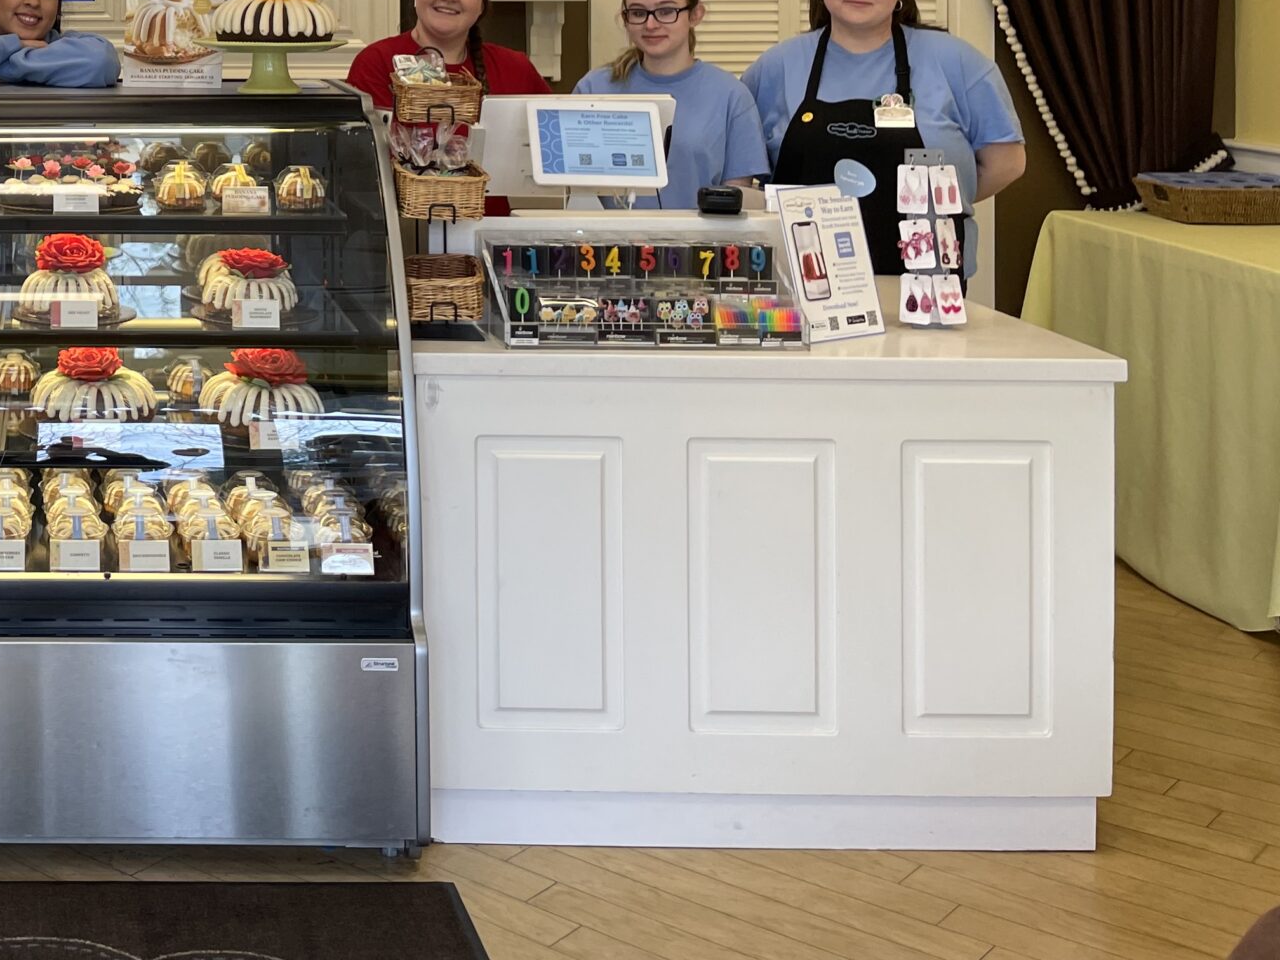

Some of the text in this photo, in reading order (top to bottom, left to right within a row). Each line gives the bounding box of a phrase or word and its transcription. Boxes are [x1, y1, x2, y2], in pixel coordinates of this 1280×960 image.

[580, 244, 596, 271] 3
[605, 245, 621, 273] 4
[639, 244, 656, 272] 5
[699, 249, 715, 276] 7
[725, 244, 740, 271] 8
[751, 245, 766, 272] 9
